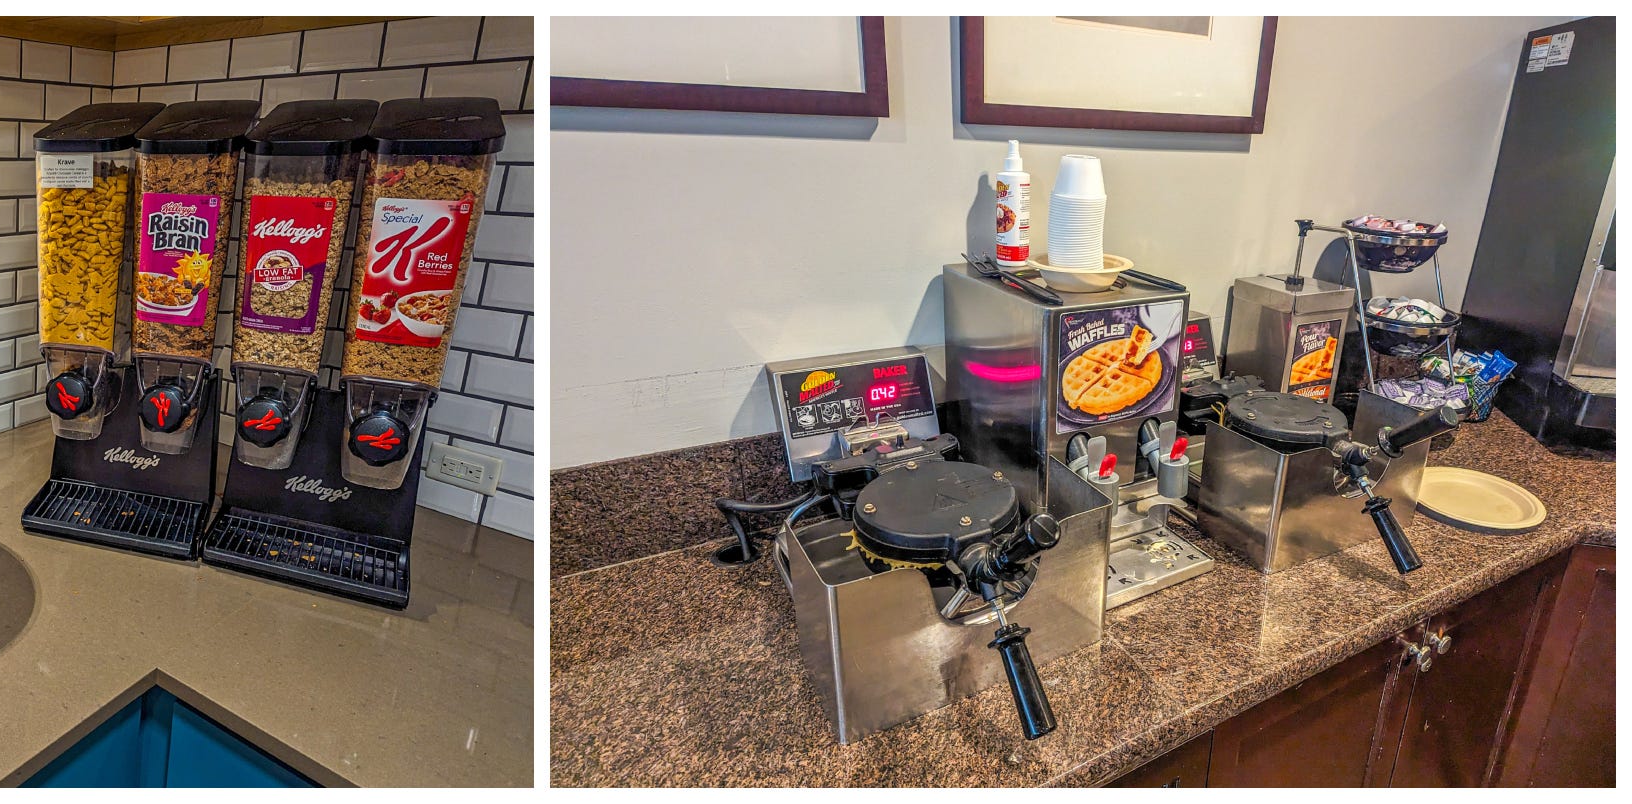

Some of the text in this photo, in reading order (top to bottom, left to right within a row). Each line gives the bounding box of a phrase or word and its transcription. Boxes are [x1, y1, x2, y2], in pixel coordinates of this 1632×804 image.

[161, 201, 197, 216] Kellogg's
[381, 212, 424, 224] Special
[382, 204, 405, 213] Kellogg's
[148, 212, 208, 238] Raisin
[252, 217, 327, 244] Kellogg's
[153, 232, 201, 253] Bran
[372, 216, 451, 281] K
[417, 259, 453, 270] Berries
[427, 252, 448, 261] Red
[259, 267, 299, 277] LOW FAT
[1068, 326, 1085, 340] Fresh
[1085, 318, 1105, 332] Baked
[1068, 323, 1125, 351] WAFFLES
[1300, 333, 1320, 346] Pour
[1303, 339, 1326, 353] Flavor
[800, 371, 837, 392] GOLDEN
[872, 364, 908, 379] BAKER
[799, 380, 835, 402] MALTED
[103, 447, 161, 470] Kellogg's
[284, 475, 353, 503] Kellogg's
